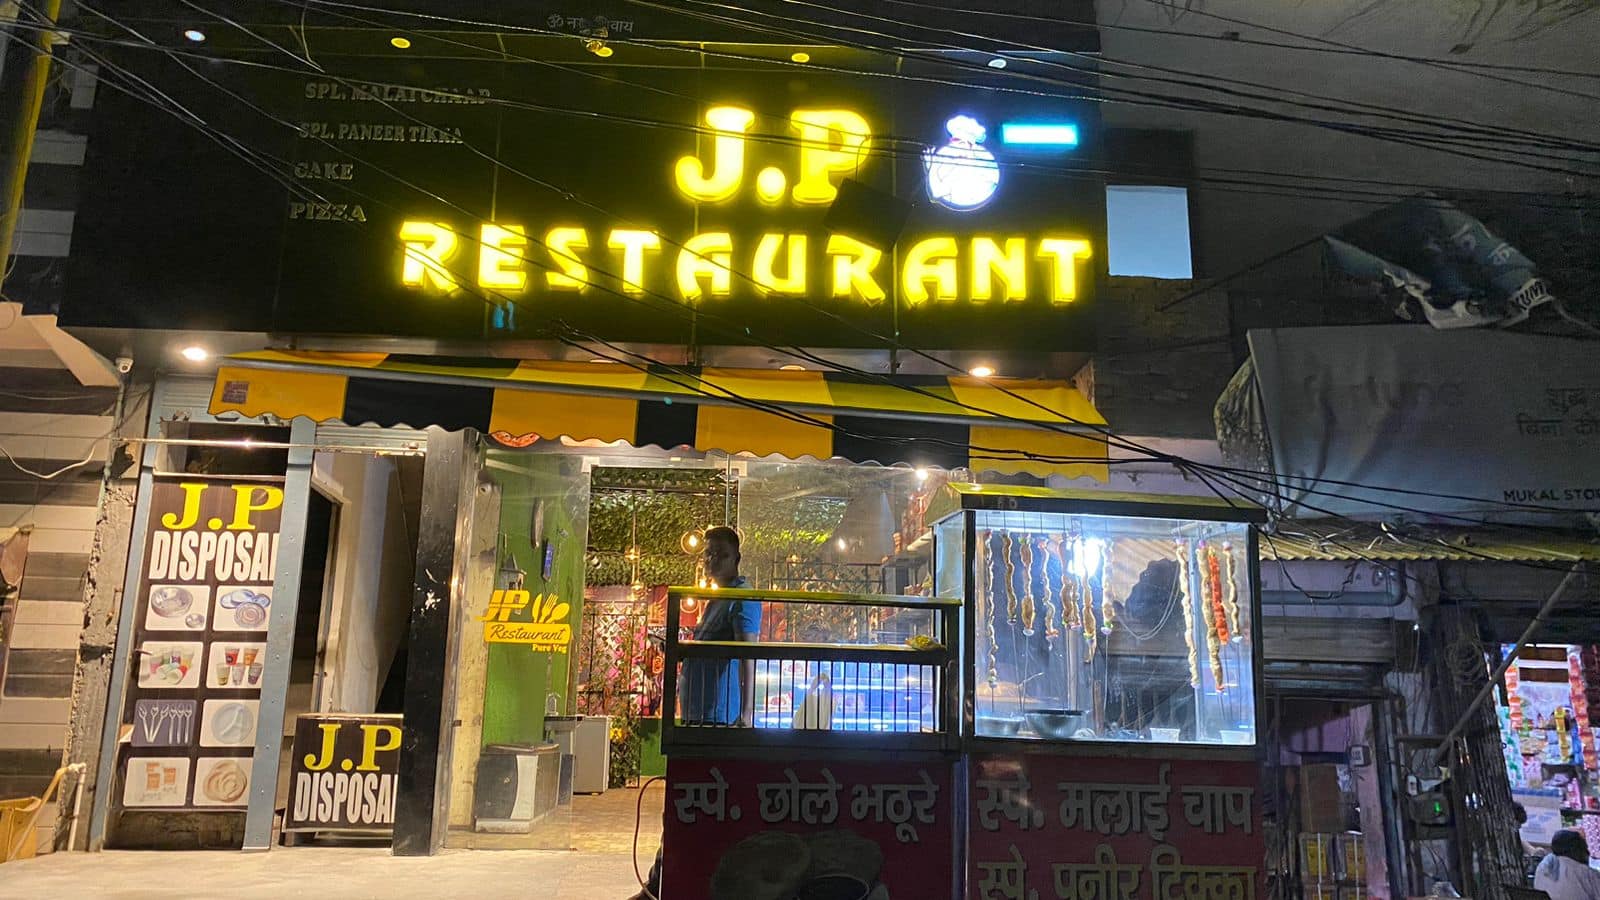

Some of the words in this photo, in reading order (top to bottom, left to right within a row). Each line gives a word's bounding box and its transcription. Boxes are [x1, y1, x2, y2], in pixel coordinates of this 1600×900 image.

[304, 82, 346, 100] SPL.
[351, 84, 416, 102] MALAI
[298, 122, 334, 139] SPL.
[338, 124, 405, 141] PANEER
[408, 126, 465, 144] TIKKA
[294, 161, 354, 180] CAKE
[675, 105, 873, 204] J.P
[288, 202, 367, 222] PIZZA
[398, 220, 1093, 307] RESTAURANT
[161, 482, 284, 531] J.P
[1503, 488, 1560, 502] MUKAL
[475, 589, 530, 622] JP
[489, 623, 566, 641] Restaurant
[532, 643, 551, 652] Pure
[553, 644, 567, 655] Veg
[304, 723, 402, 771] J.P
[673, 767, 742, 824] स्पे.
[757, 767, 843, 825] छोले
[976, 773, 1045, 832] स्पे.
[1057, 763, 1171, 842] मलाई
[1181, 785, 1255, 834] चाप
[976, 844, 1042, 900] स्पे.
[1052, 843, 1144, 900] पनीर
[1150, 843, 1258, 900] टिक्का
